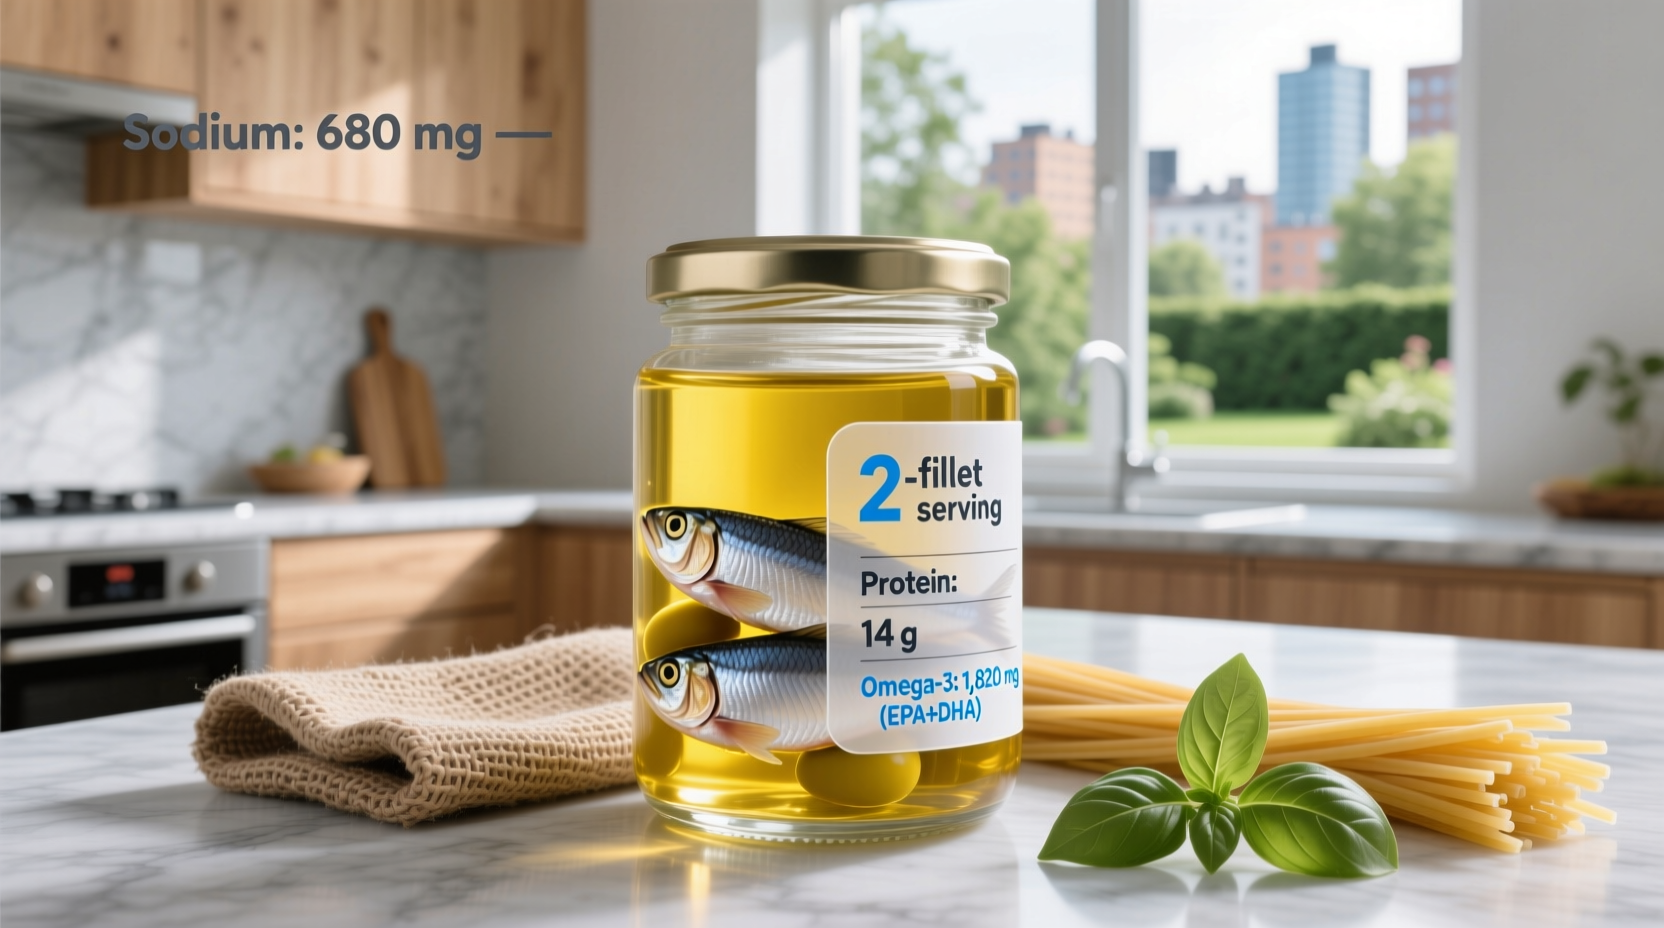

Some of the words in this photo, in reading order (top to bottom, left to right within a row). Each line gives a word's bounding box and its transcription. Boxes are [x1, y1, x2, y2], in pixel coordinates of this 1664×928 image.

[917, 493, 1002, 526] serving
[861, 568, 957, 596] Protein:
[861, 619, 894, 648] 14
[900, 626, 917, 653] g
[861, 672, 958, 701] Omega-3:
[962, 666, 1001, 695] 1,820
[1004, 667, 1019, 688] mg
[880, 696, 981, 731] (EPA+DHA)
